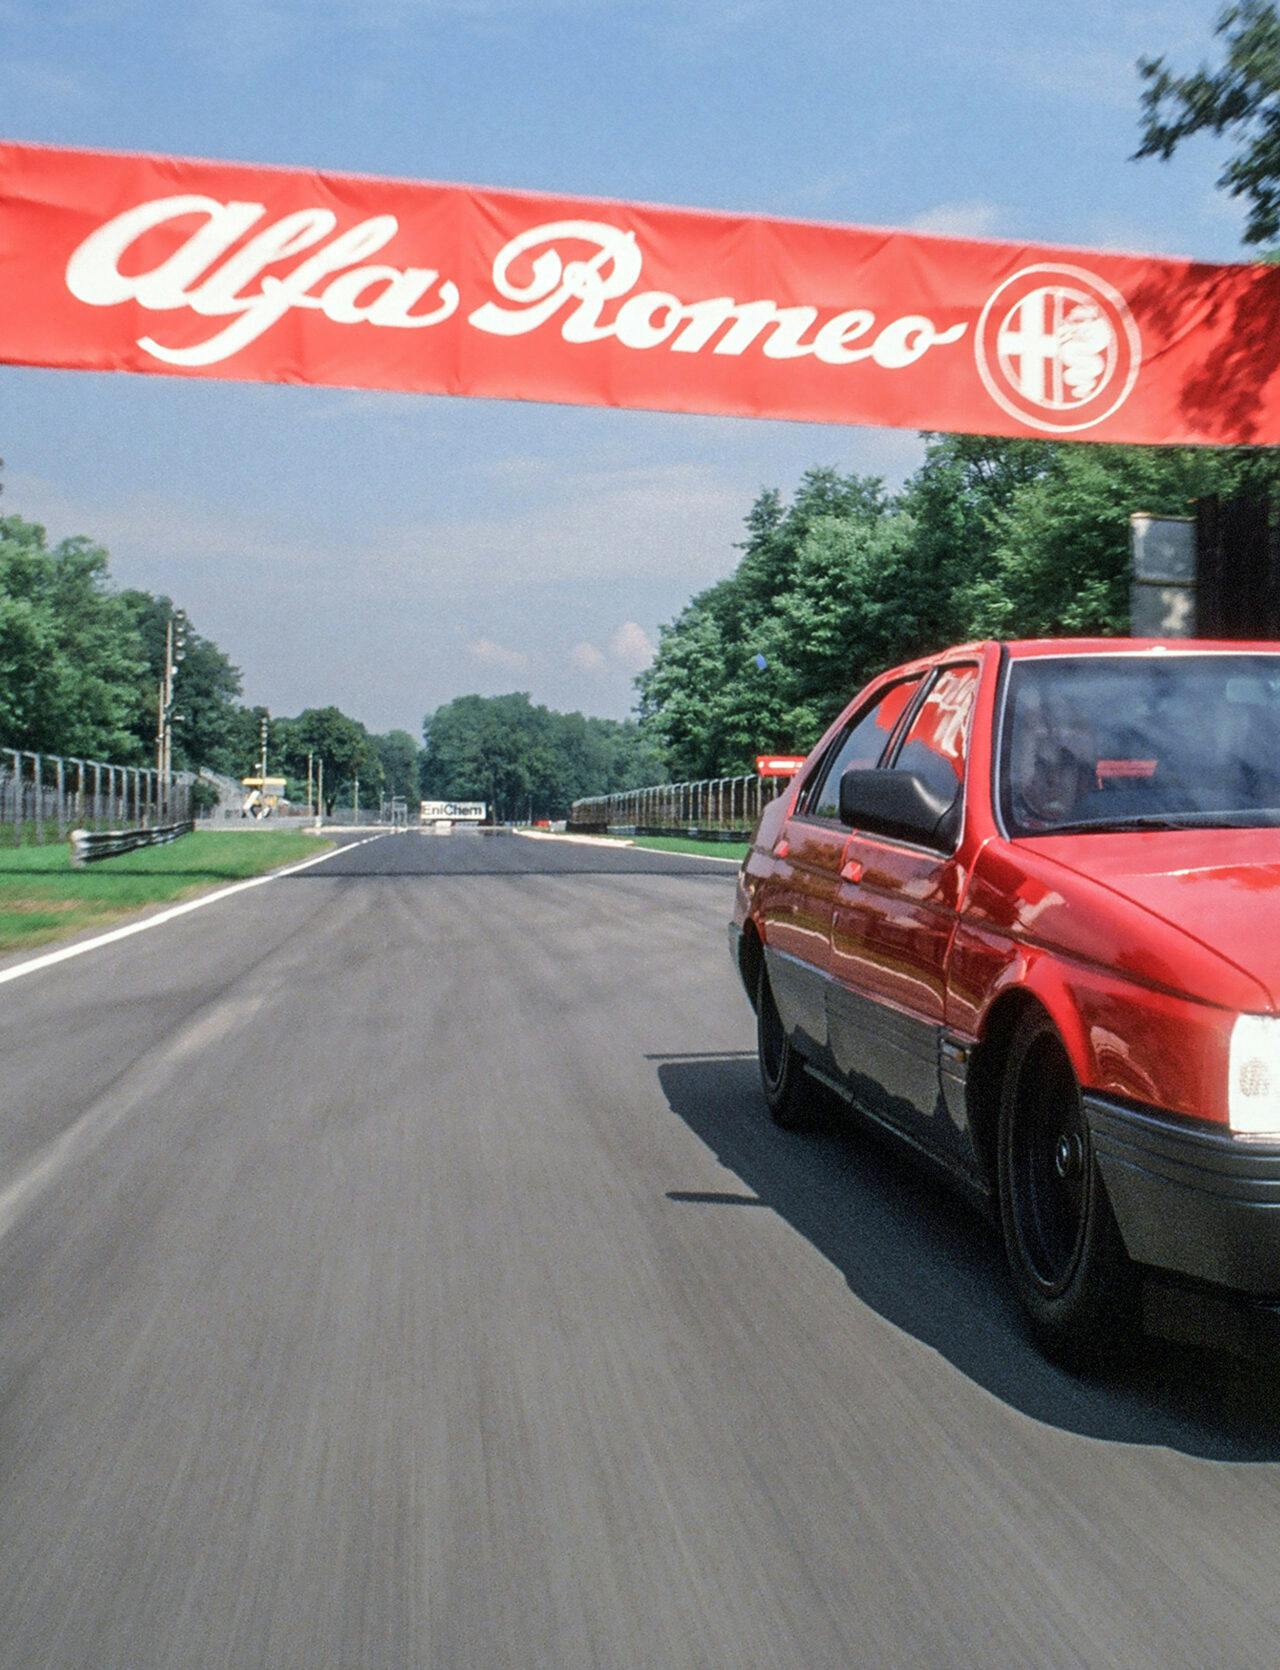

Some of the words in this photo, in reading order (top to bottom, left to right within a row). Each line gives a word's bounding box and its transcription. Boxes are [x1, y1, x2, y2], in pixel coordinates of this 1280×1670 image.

[66, 195, 459, 366] Alfa
[468, 220, 967, 368] Romeo
[422, 804, 483, 816] EniChem
